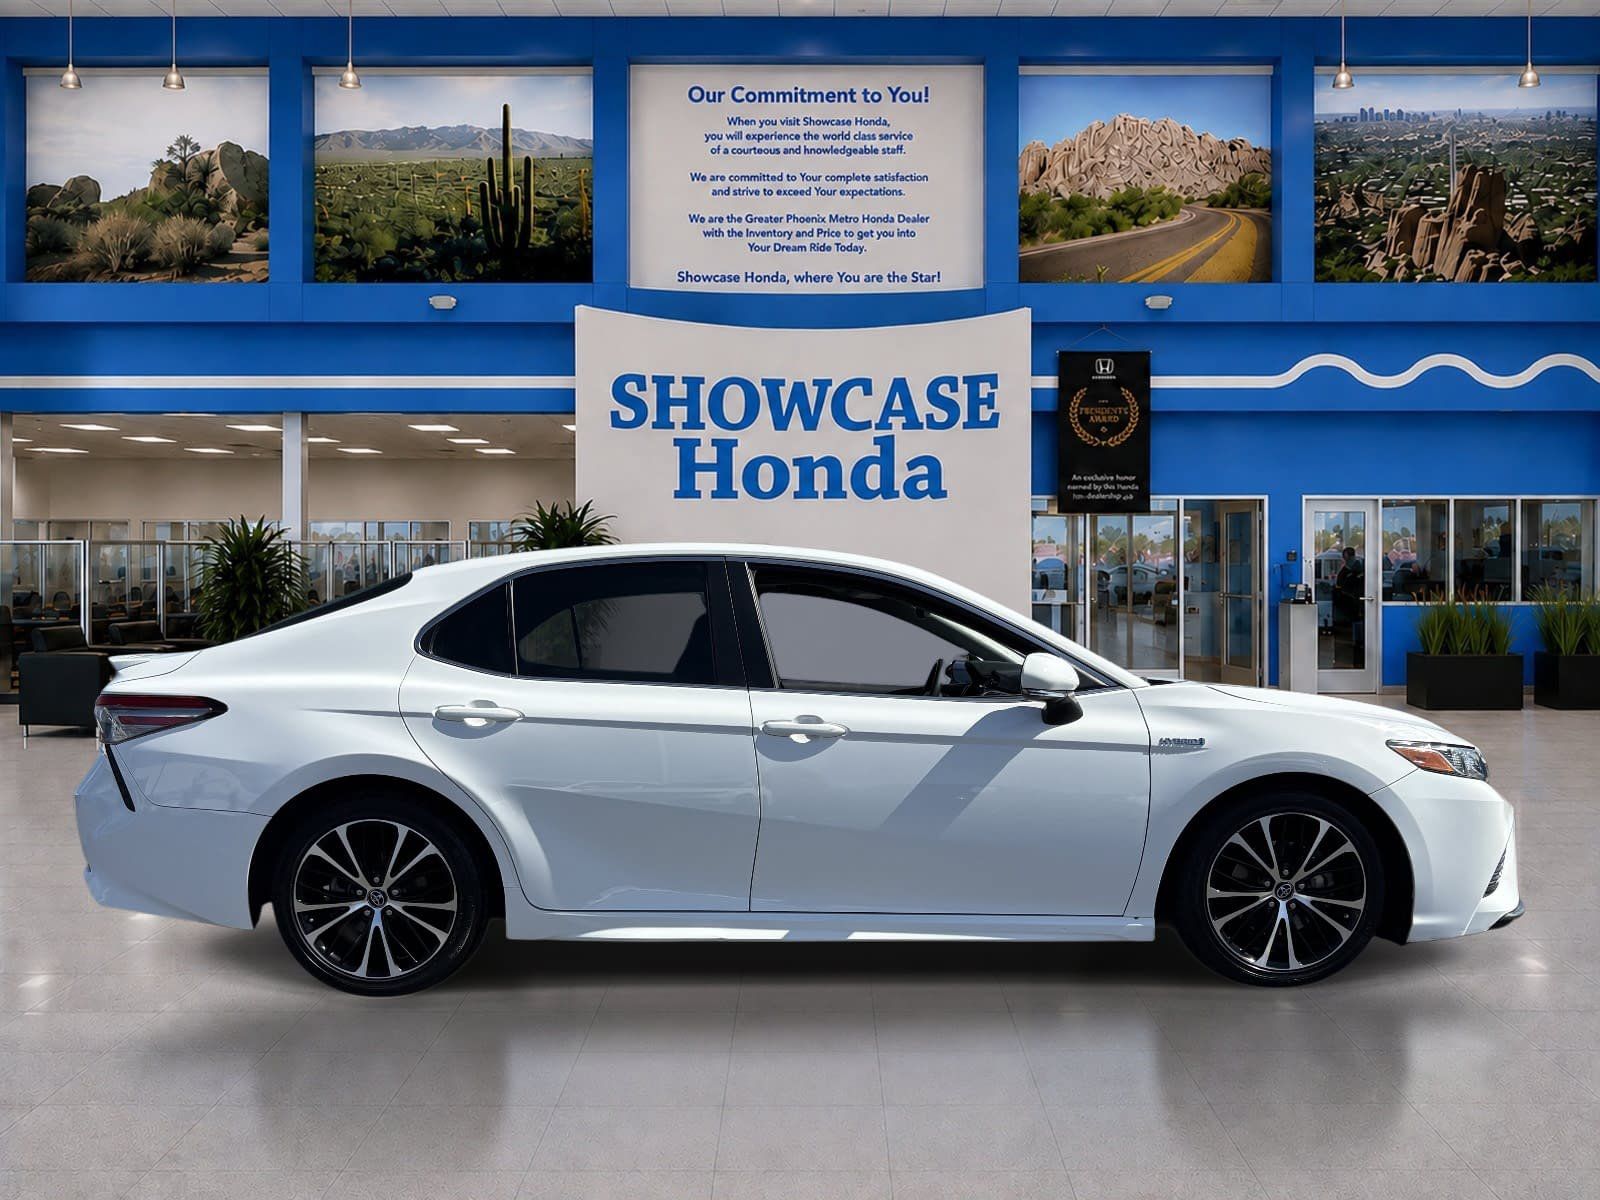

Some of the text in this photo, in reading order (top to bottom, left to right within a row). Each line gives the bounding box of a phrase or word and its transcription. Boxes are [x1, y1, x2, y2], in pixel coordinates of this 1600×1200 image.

[687, 85, 930, 104] Our Commitment to You!
[726, 115, 891, 129] When you visit Showcase Honda,
[704, 130, 914, 144] you will experience the world class service
[709, 144, 722, 155] of
[722, 147, 730, 155] a
[730, 146, 782, 156] courteous
[782, 144, 802, 155] and
[881, 143, 907, 155] staff.
[689, 171, 929, 185] We are committed to Your complete satisfaction
[711, 185, 906, 200] and strive to exceed Your expectations.
[688, 213, 931, 225] We are the Greater Phoenix Metro Honda Dealer
[702, 227, 917, 241] with the Inventory and Price to get you into
[747, 241, 868, 255] Your Dream Ride Today.
[676, 270, 941, 286] Showcase Honda, where You are the Star!
[610, 372, 1001, 431] SHOWCASE
[672, 433, 948, 501] Honda
